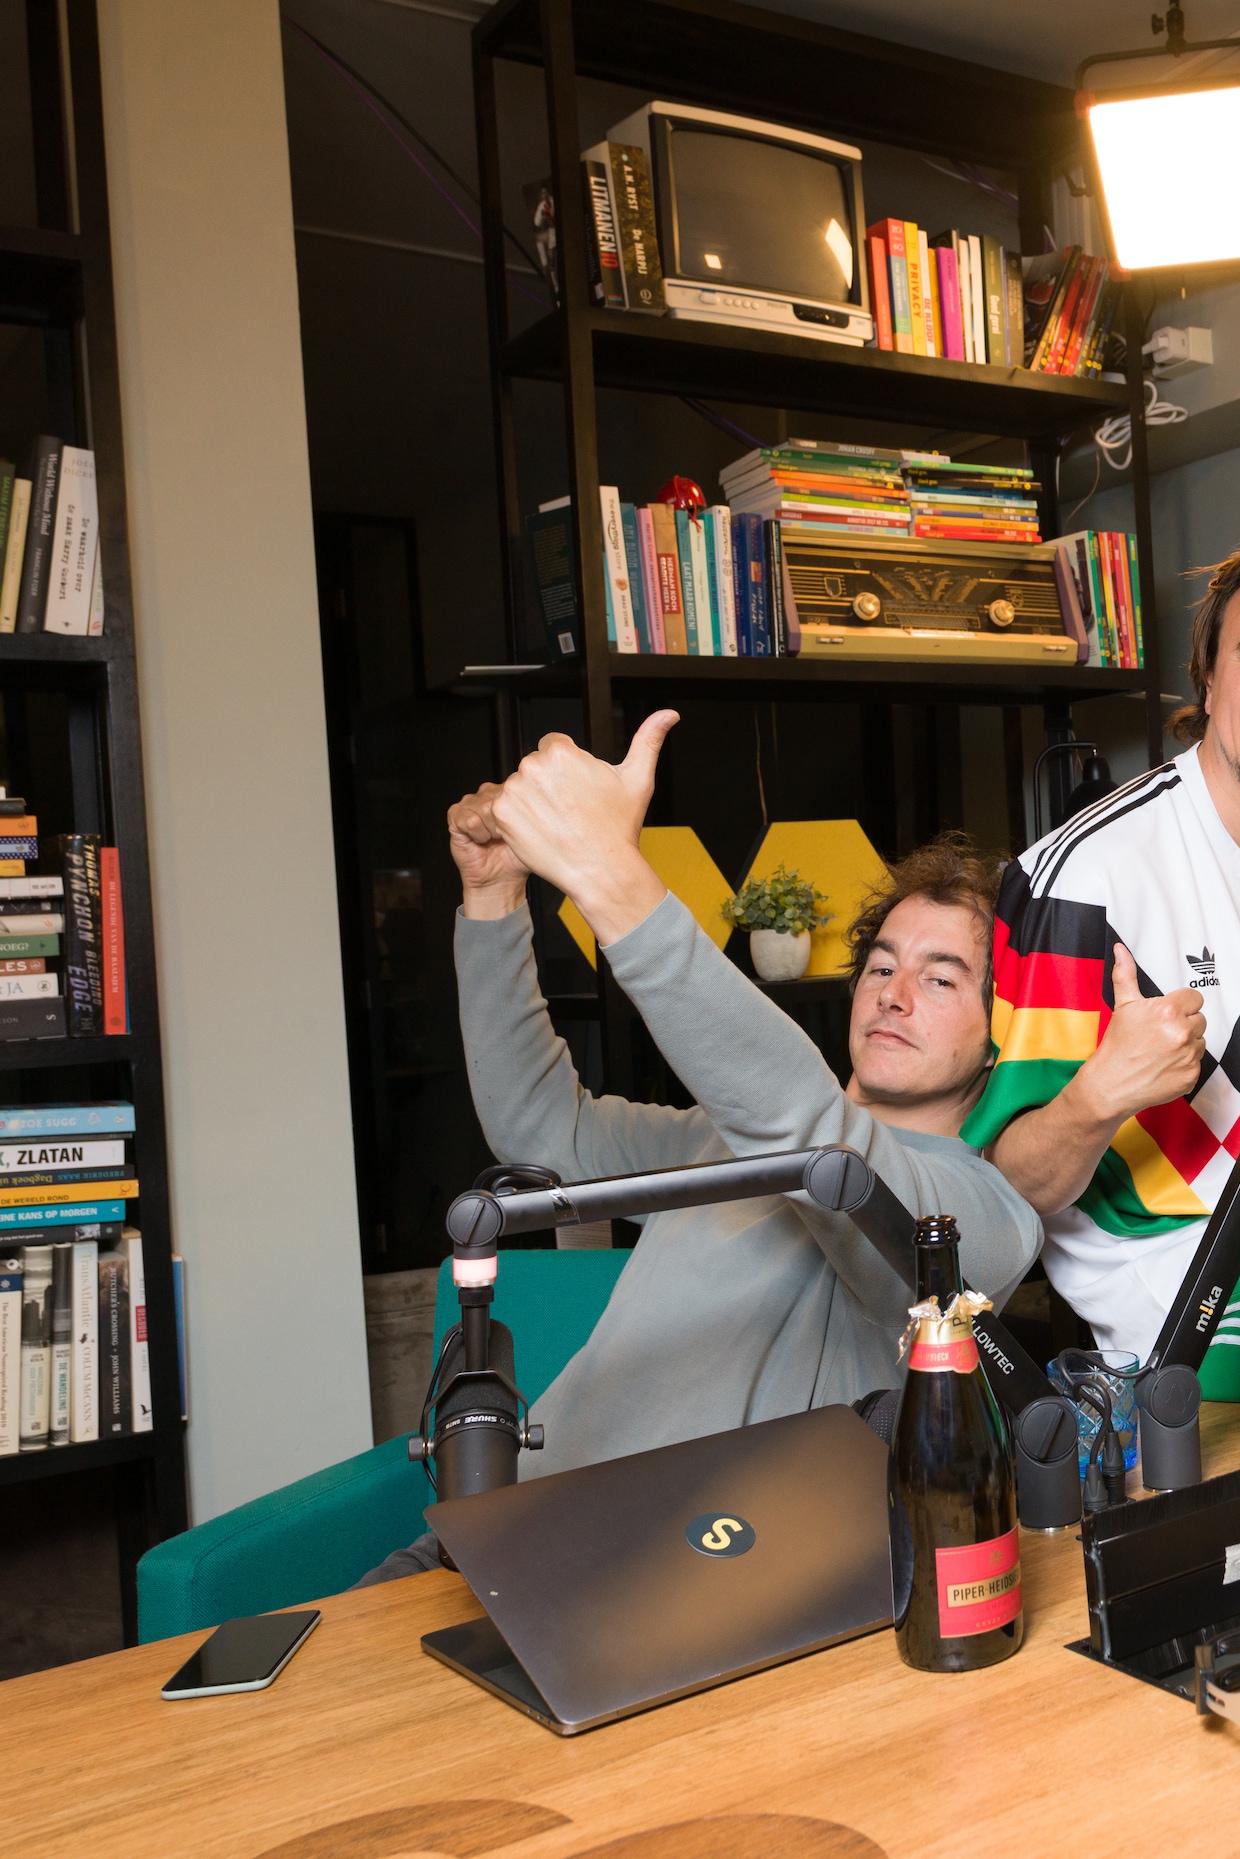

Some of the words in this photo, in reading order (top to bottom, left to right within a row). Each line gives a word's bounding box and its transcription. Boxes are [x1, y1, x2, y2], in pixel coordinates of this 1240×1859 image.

[626, 187, 639, 211] RYST
[632, 229, 642, 240] De
[634, 242, 648, 274] HARPIJ
[910, 262, 922, 319] PRIVACY
[46, 453, 58, 478] World
[64, 468, 94, 479] DICKE
[44, 478, 55, 512] Without
[68, 504, 76, 513] de
[40, 512, 52, 536] Mind
[82, 518, 90, 529] De
[608, 510, 620, 550] everything
[62, 540, 72, 564] Harry
[78, 531, 88, 570] waarheid
[33, 548, 42, 580] FRANKLIN
[667, 557, 676, 588] HERMAN
[682, 562, 692, 580] LAAT
[670, 590, 678, 611] KOCH
[685, 581, 694, 601] MAAR
[83, 844, 100, 896] THOMAS
[66, 851, 94, 945] PYNCHON
[109, 881, 116, 891] DE
[111, 945, 117, 955] DE
[6, 982, 24, 995] JA
[68, 965, 93, 1013] EDGE
[85, 949, 102, 1005] BLEEDING
[46, 1117, 77, 1126] SUGG
[17, 1147, 84, 1165] ZLATAN
[12, 1174, 53, 1185] Dagboek
[58, 1172, 80, 1180] BAAS
[83, 1170, 124, 1179] FREDERIK
[14, 1196, 45, 1204] WERELD
[18, 1211, 42, 1220] KANS
[45, 1210, 58, 1218] OP
[60, 1208, 98, 1218] MORGEN
[80, 1252, 94, 1328] TransAtlantic
[110, 1268, 118, 1308] BUTCHER'S
[110, 1309, 118, 1345] CROSSING
[59, 1362, 67, 1370] DE
[83, 1347, 91, 1381] COLUM
[111, 1355, 119, 1374] JOHN
[59, 1373, 67, 1411] WANDELING
[84, 1384, 92, 1421] McCANN
[112, 1376, 120, 1414] WILLIAMS
[464, 1416, 498, 1424] SHURE
[701, 1518, 743, 1550] S
